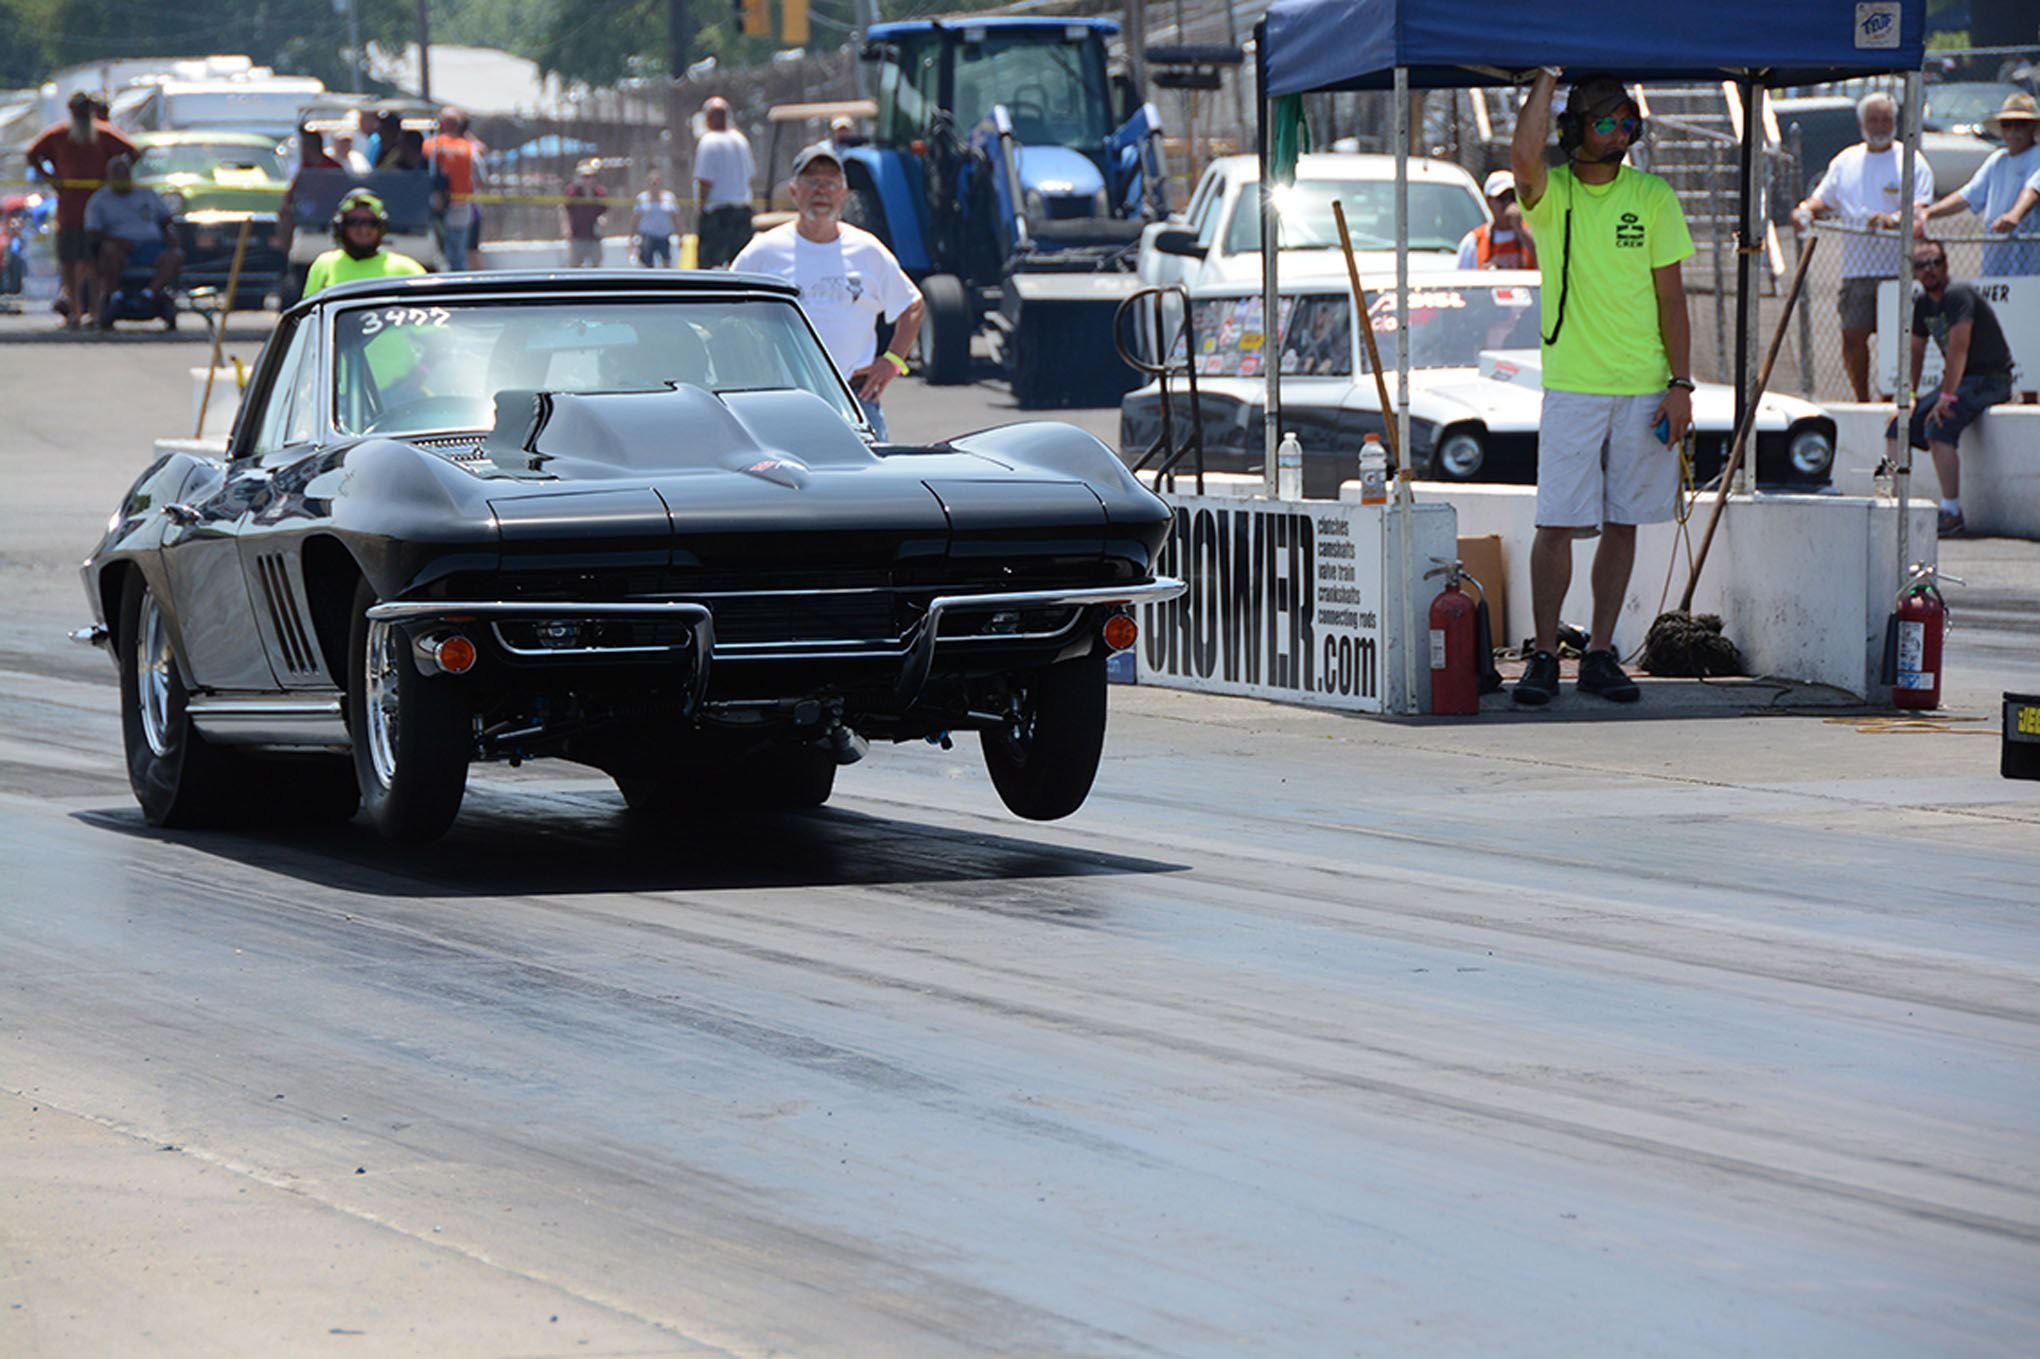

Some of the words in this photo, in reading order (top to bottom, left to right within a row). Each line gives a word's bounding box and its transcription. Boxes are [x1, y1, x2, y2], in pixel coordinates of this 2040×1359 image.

[1318, 515, 1349, 536] clutches
[1318, 540, 1355, 559] camshafts
[1318, 562, 1336, 580] valve
[1338, 563, 1355, 581] train
[1318, 584, 1360, 605] crankshafts
[1318, 607, 1358, 629] connecting
[1359, 610, 1376, 629] rods
[1318, 633, 1376, 698] .com
